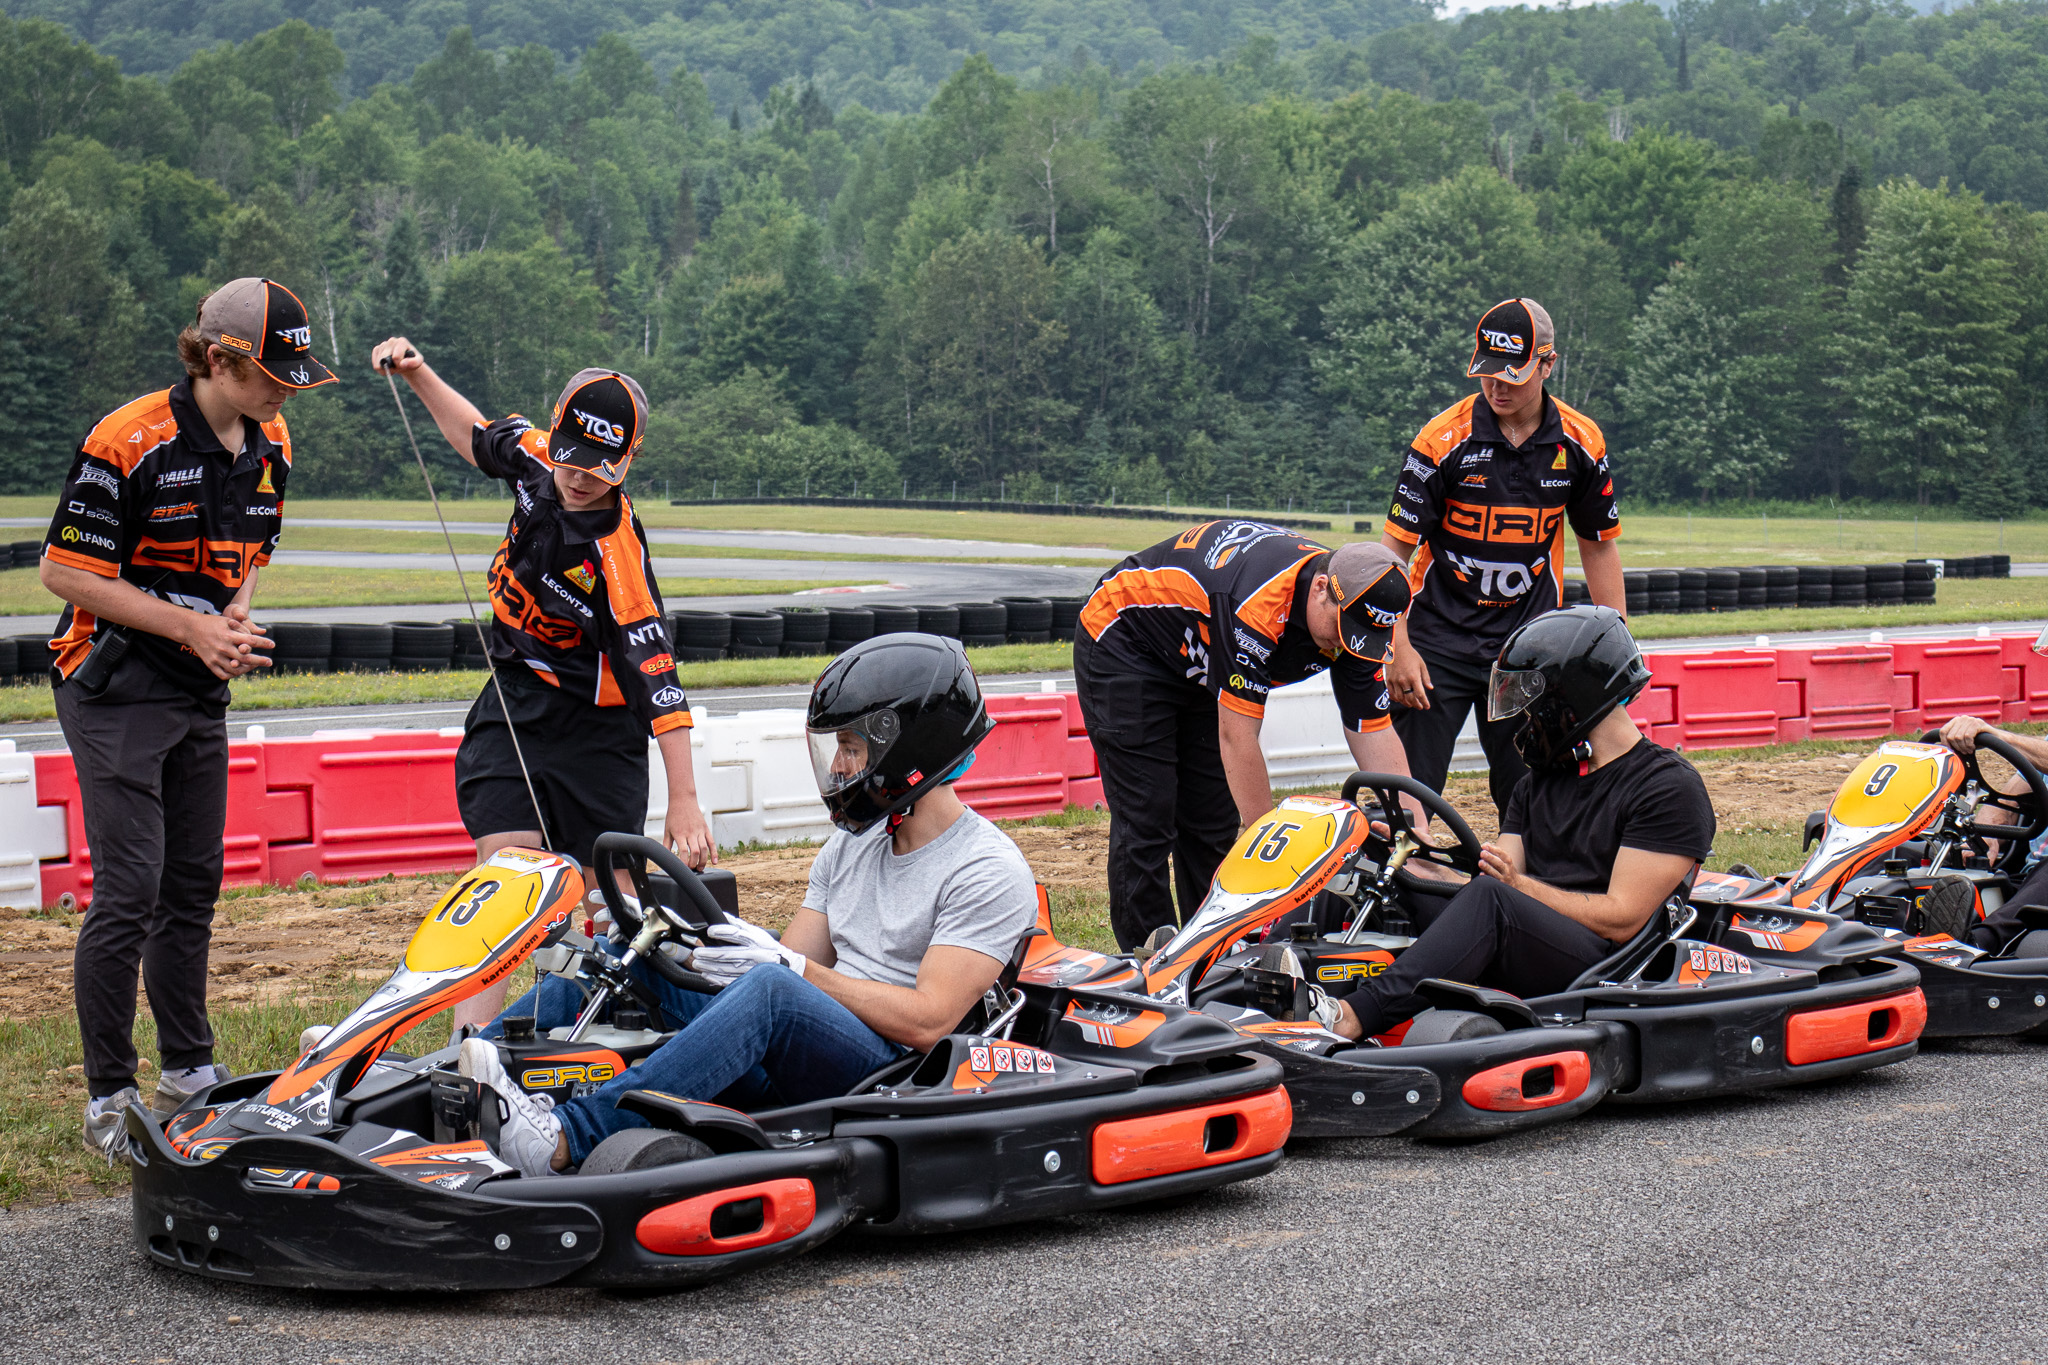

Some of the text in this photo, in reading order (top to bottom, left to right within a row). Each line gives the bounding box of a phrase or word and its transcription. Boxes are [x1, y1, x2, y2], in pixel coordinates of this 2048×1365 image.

[86, 510, 119, 526] SOCO
[61, 525, 116, 551] ALFANO
[134, 539, 262, 584] CR
[1863, 763, 1900, 797] 9
[1243, 820, 1303, 863] 15
[1293, 861, 1339, 903] kartcrg.com
[434, 877, 502, 927] 13
[481, 934, 539, 986] kartcrg.com
[1316, 962, 1389, 982] CRG
[521, 1062, 615, 1090] CRG
[264, 1117, 293, 1133] LINE
